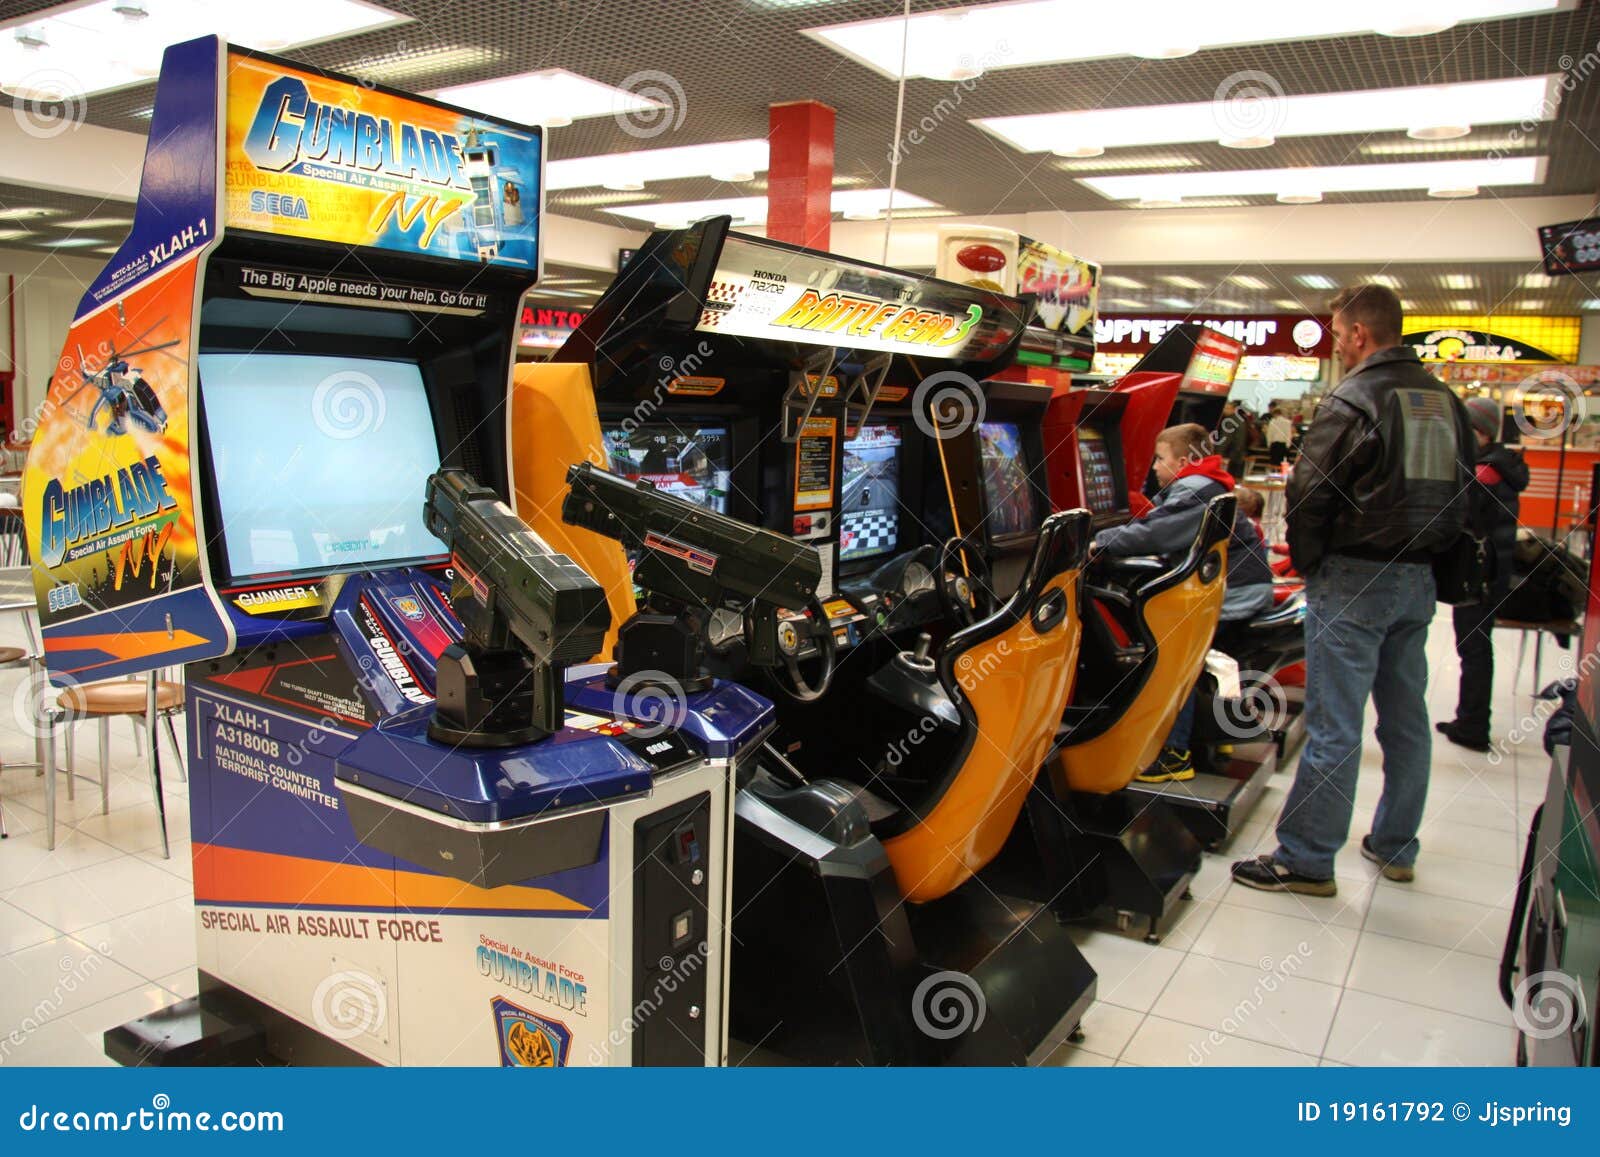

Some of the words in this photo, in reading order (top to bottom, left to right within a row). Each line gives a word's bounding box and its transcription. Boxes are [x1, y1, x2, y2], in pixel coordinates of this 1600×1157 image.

[243, 76, 472, 191] GUNBLADE
[302, 163, 347, 182] Special
[350, 173, 367, 186] Air
[369, 176, 409, 194] Assault
[250, 190, 309, 219] SEGA
[368, 190, 464, 250] NY
[149, 218, 208, 268] XLAH-1
[241, 268, 268, 286] The
[272, 272, 294, 292] Big
[298, 275, 337, 295] Apple
[340, 280, 377, 297] needs
[380, 286, 408, 302] your
[410, 286, 437, 304] help.
[440, 291, 456, 305] Go
[457, 292, 473, 306] for
[474, 294, 486, 307] it!
[753, 270, 787, 283] HONDA
[520, 306, 587, 329] ANTO
[769, 288, 902, 337] BATTLE
[880, 306, 956, 345] GEAR
[935, 303, 984, 347] 3
[1094, 319, 1184, 344] УРГЕ
[1192, 319, 1277, 346] ИНГ
[41, 455, 178, 569] GUNBLADE
[69, 543, 94, 559] Special
[95, 540, 106, 551] Air
[107, 531, 135, 547] Assault
[135, 523, 158, 538] Force
[114, 522, 174, 591] NY
[48, 583, 82, 612] SEGA
[238, 587, 307, 607] GUNNER
[311, 585, 320, 597] 1
[370, 636, 437, 704] GUNBLA
[214, 703, 270, 735] XLAH-1
[215, 723, 280, 758] A318008
[645, 740, 673, 755] SEGA
[215, 745, 267, 772] NATIONAL
[268, 762, 321, 791] COUNTER
[215, 755, 271, 784] TERRORIST
[272, 777, 339, 810] COMMITTEE
[200, 910, 261, 933] SPECIAL
[266, 914, 291, 934] AIR
[297, 915, 370, 939] ASSAULT
[377, 919, 443, 943] FORCE
[479, 934, 508, 954] Special
[510, 946, 523, 959] Air
[524, 951, 557, 973] Assault
[559, 965, 585, 983] Force
[476, 945, 588, 1017] GUNBLADE
